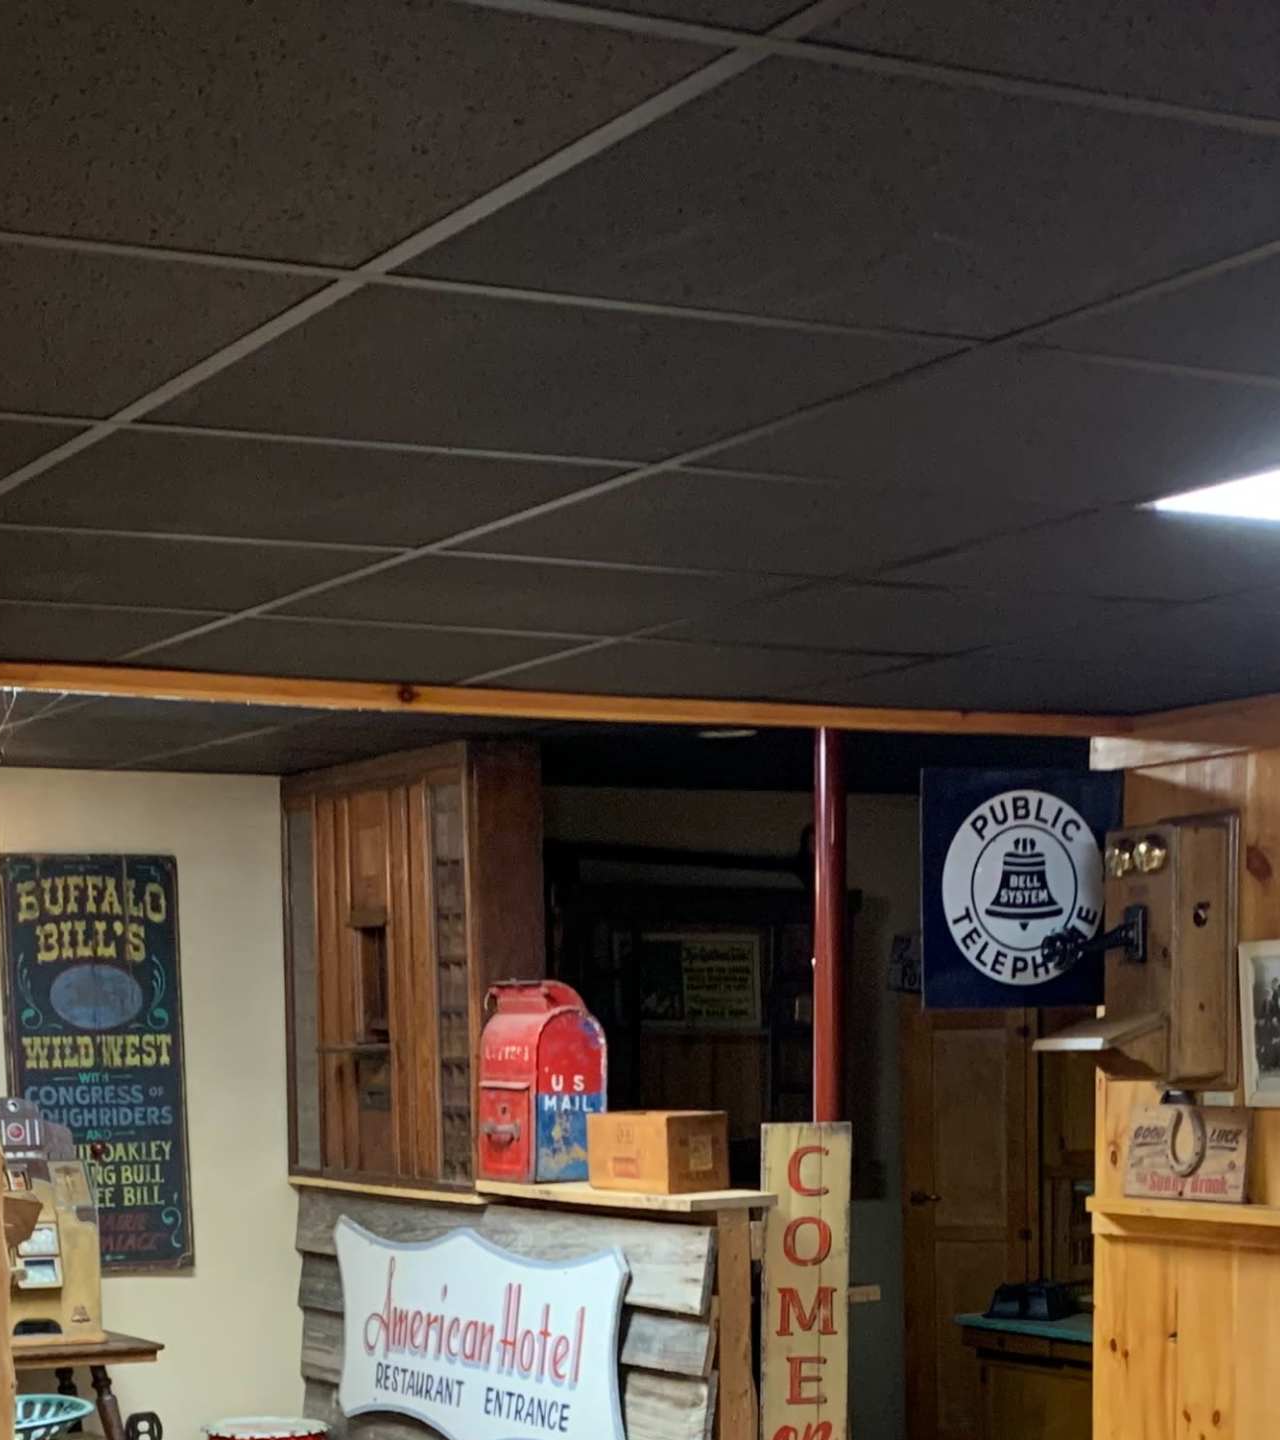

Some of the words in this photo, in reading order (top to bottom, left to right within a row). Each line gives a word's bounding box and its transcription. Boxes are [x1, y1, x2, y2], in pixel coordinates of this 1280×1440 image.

[970, 796, 1081, 841] PUBLIC
[1009, 874, 1041, 888] BELL
[17, 875, 167, 924] BUFFALO
[1000, 889, 1048, 905] SYSTEM
[35, 921, 147, 963] BILL'S
[952, 905, 1098, 980] TELEPHE
[22, 1034, 94, 1070] WILD
[96, 1033, 173, 1068] WEST
[78, 1072, 110, 1084] WITH
[25, 1084, 144, 1105] CONGRESS
[148, 1086, 165, 1097] OF
[544, 1094, 593, 1113] MAIL
[40, 1106, 173, 1127] OUGHRIDERS
[86, 1129, 112, 1140] AND
[102, 1141, 172, 1162] OAKLEY
[121, 1164, 165, 1184] BULL
[123, 1186, 165, 1206] BILL
[775, 1145, 837, 1406] COME
[363, 1256, 495, 1362] American
[500, 1282, 586, 1384] Hotel
[375, 1361, 465, 1406] RESTAURANT
[484, 1386, 572, 1433] ENTRANCE
